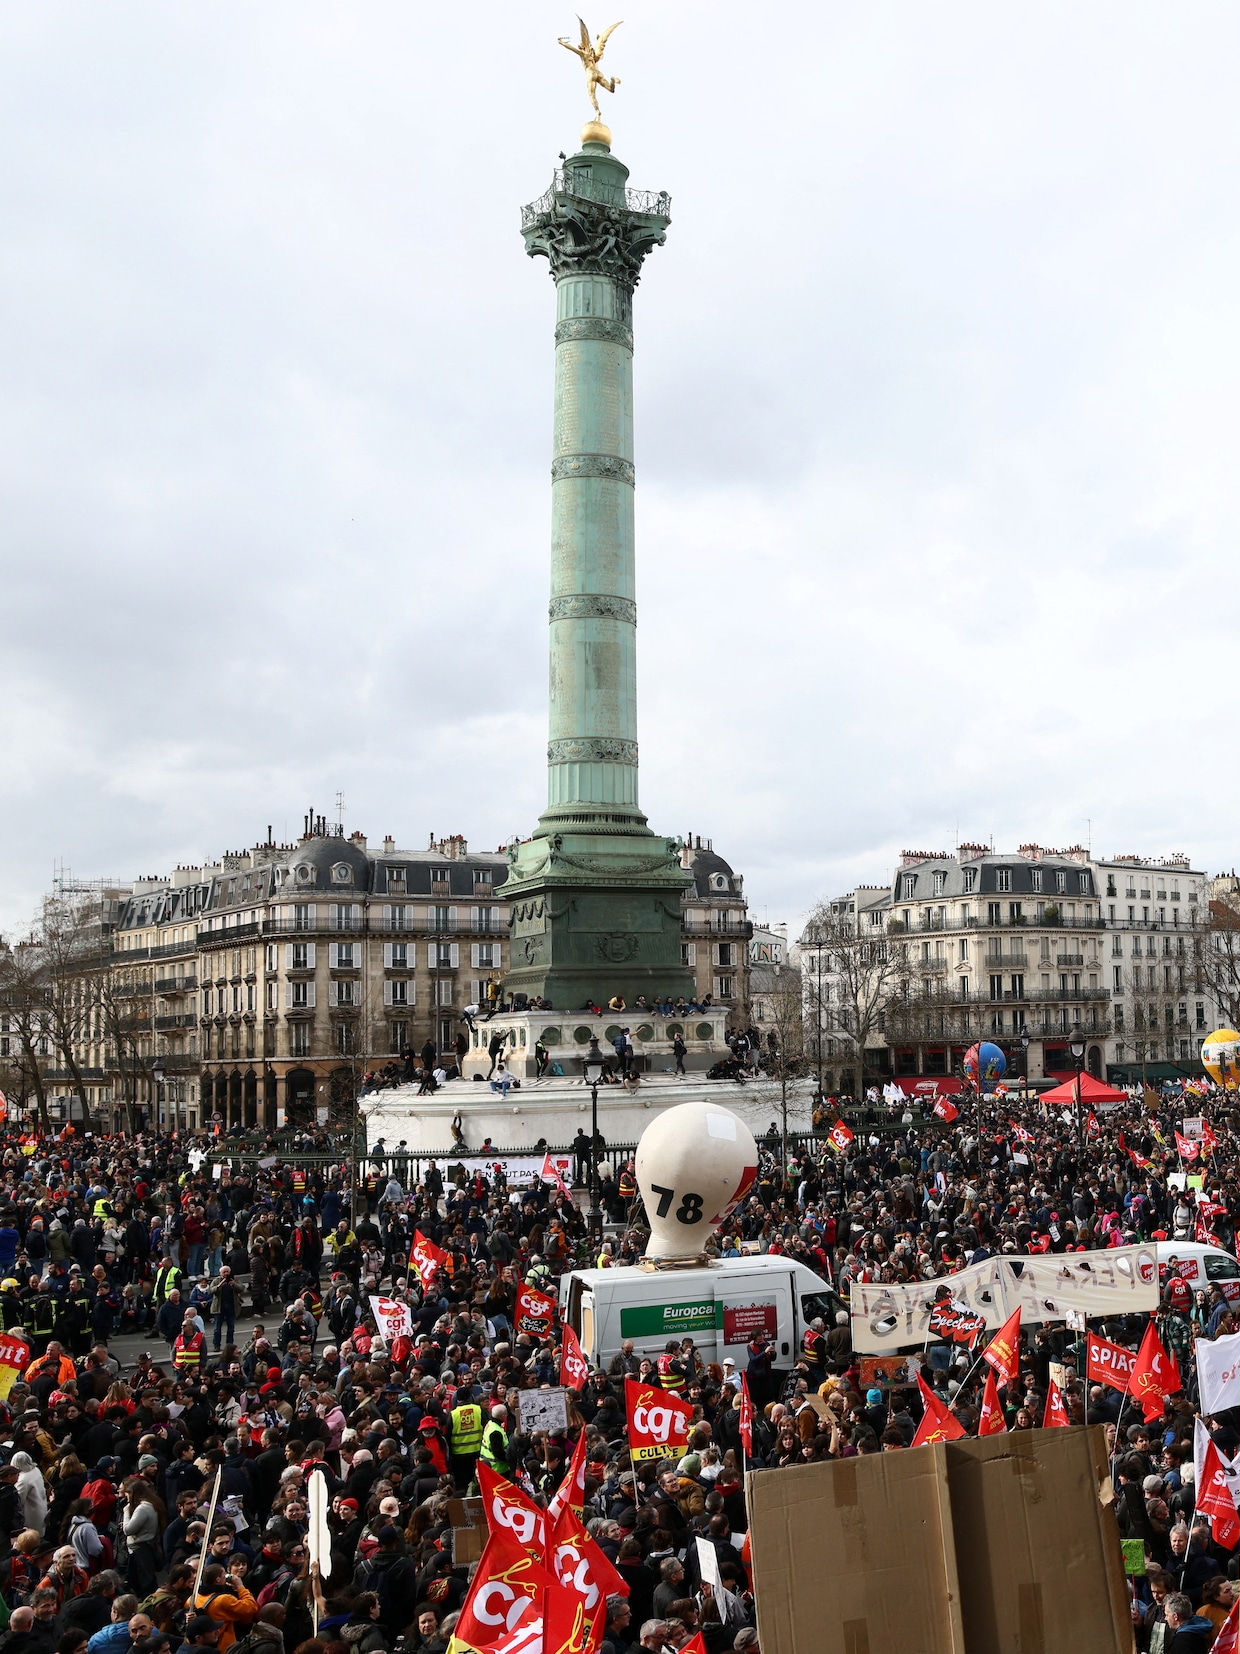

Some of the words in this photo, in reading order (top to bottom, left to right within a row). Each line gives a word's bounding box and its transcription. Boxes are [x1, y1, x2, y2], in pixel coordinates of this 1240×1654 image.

[651, 1183, 704, 1225] 78
[1175, 1285, 1187, 1295] cgt
[520, 1295, 550, 1317] cgt
[386, 1317, 406, 1331] cgt
[663, 1323, 687, 1332] moving
[931, 1306, 984, 1331] Spectacle
[634, 1407, 687, 1442] cgt
[640, 1445, 678, 1459] CULTE
